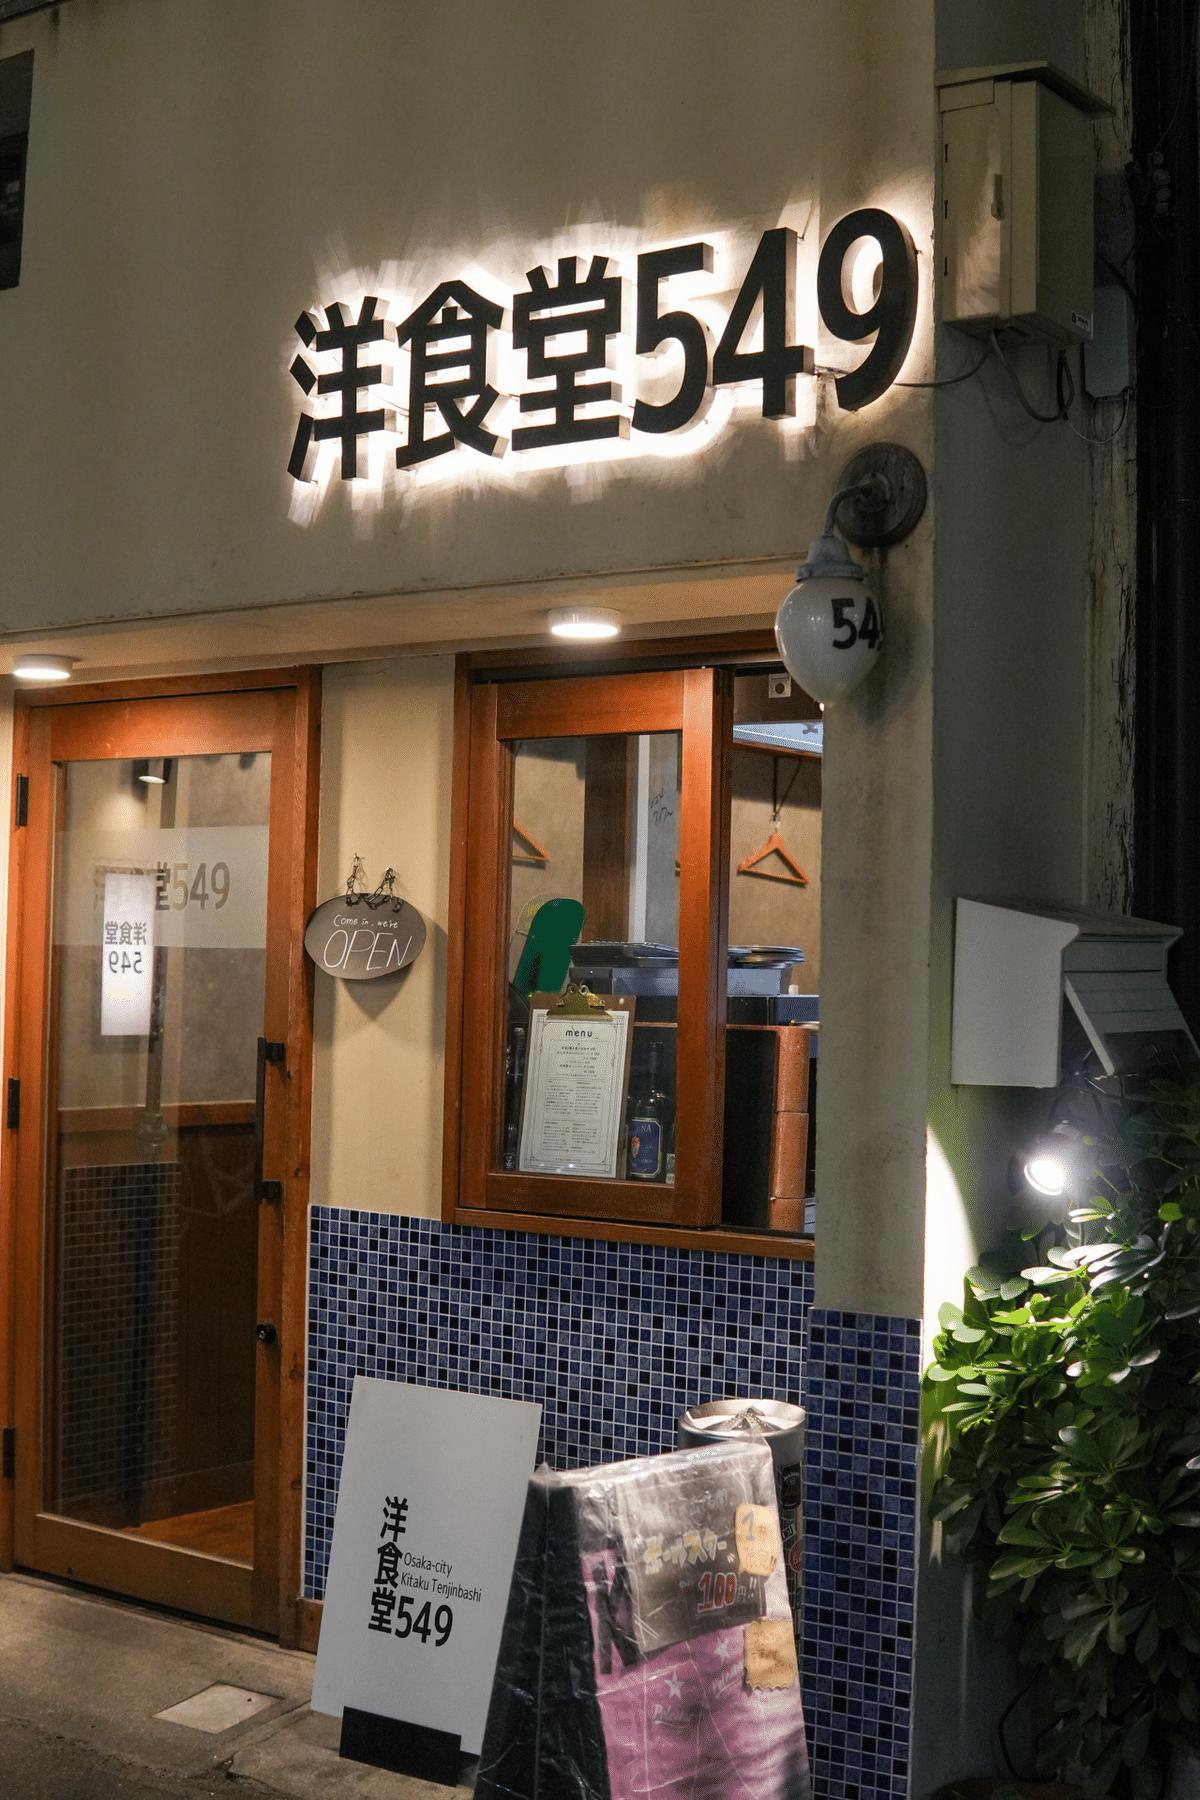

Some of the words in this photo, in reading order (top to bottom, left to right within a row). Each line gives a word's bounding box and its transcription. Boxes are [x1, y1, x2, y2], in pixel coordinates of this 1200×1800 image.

[287, 208, 919, 482] 洋食堂549
[831, 596, 884, 652] 54
[333, 915, 358, 927] Come
[323, 929, 413, 971] OPEN
[565, 1029, 593, 1038] menu
[368, 1496, 409, 1634] 洋食堂
[403, 1552, 453, 1579] Osaka-city
[400, 1572, 430, 1591] Kitaku
[431, 1578, 482, 1602] Tenjinbashi
[394, 1595, 454, 1647] 549
